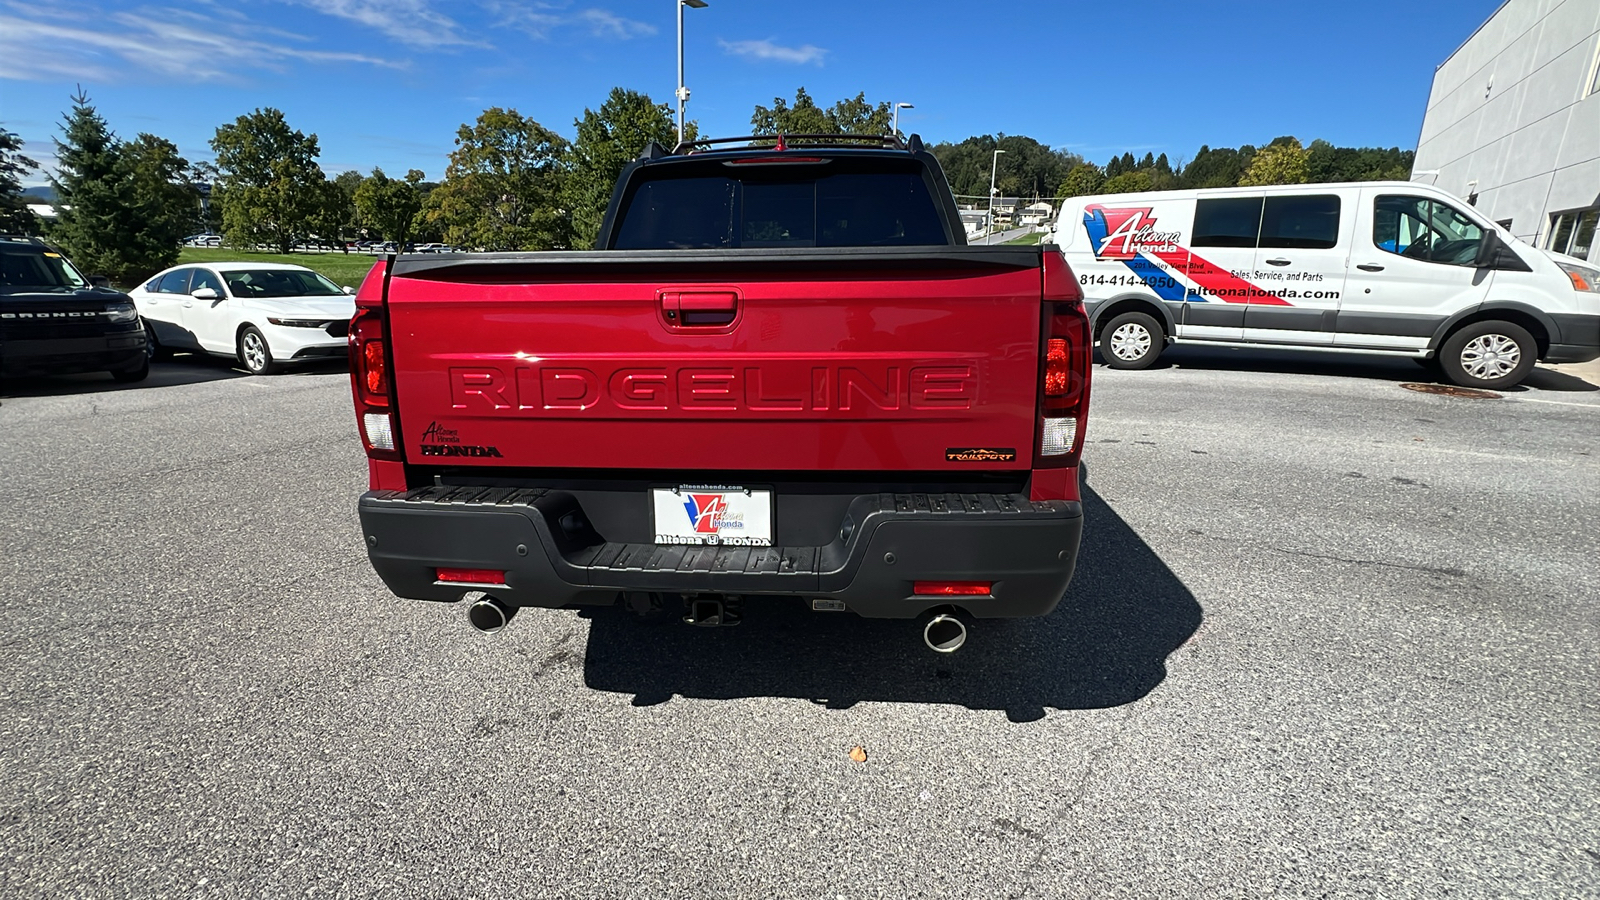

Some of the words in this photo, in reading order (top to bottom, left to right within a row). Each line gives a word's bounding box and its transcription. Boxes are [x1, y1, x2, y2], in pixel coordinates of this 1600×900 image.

[1096, 211, 1181, 254] Altoona
[1129, 242, 1178, 253] Honda
[1148, 262, 1168, 271] Valley
[1080, 274, 1176, 289] 814-414-4950
[1230, 269, 1252, 280] Sales,
[1254, 270, 1284, 282] Service,
[1286, 272, 1300, 281] and
[1302, 272, 1323, 282] Parts
[1187, 286, 1340, 299] altoonahonda.com
[1, 311, 96, 319] BRONCO
[448, 366, 970, 410] RIDGELINE
[422, 421, 458, 443] Altoona
[420, 444, 504, 458] HONDA
[947, 453, 1014, 461] TRAILSPORT
[714, 520, 743, 528] Honda
[654, 534, 703, 545] Altoona
[722, 537, 772, 547] HONDA
